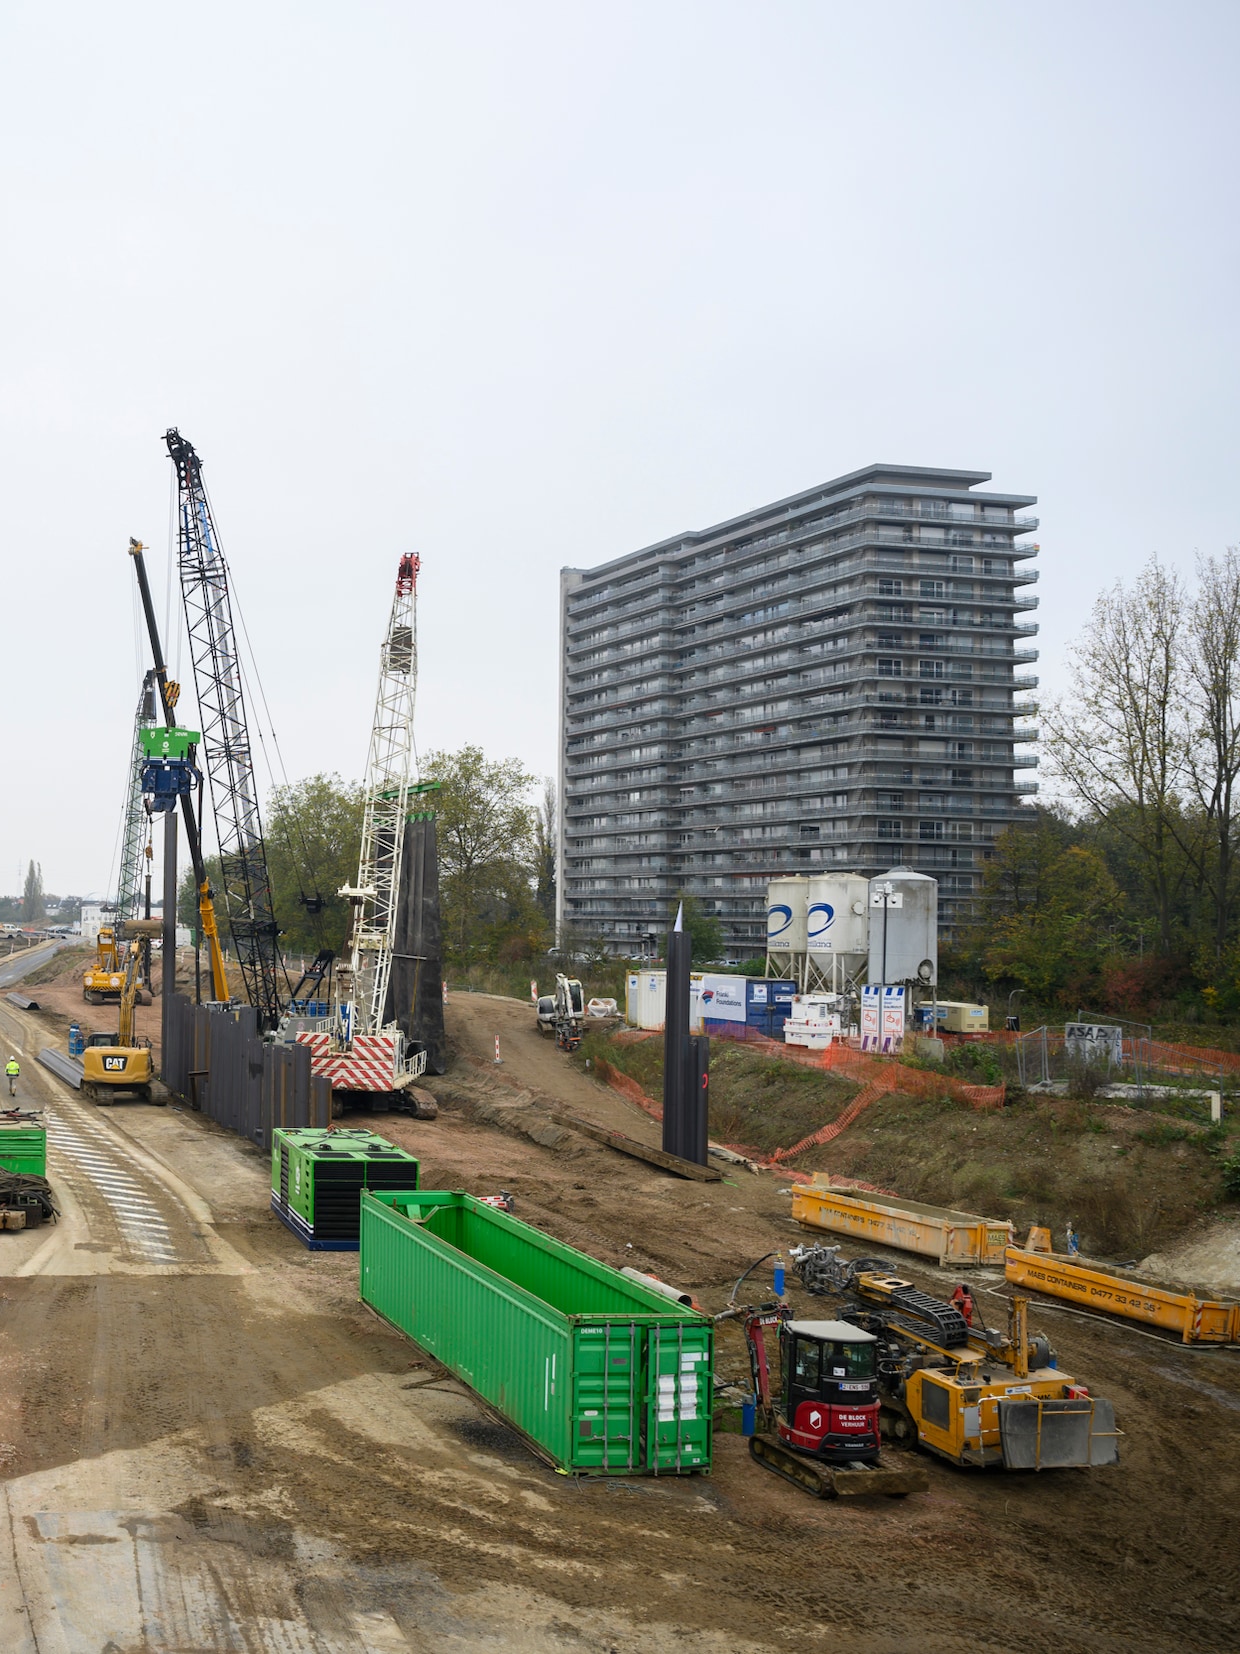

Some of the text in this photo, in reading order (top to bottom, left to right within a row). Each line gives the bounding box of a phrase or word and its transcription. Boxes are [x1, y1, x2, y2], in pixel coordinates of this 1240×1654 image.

[716, 998, 742, 1007] Foundations
[106, 1057, 124, 1070] CAT
[1027, 1269, 1046, 1281] MAES
[1047, 1275, 1087, 1293] CONTAINERS
[1090, 1287, 1113, 1300] 0477
[1115, 1293, 1128, 1304] 33
[1129, 1298, 1141, 1308] 42
[765, 1316, 778, 1324] BLOCK
